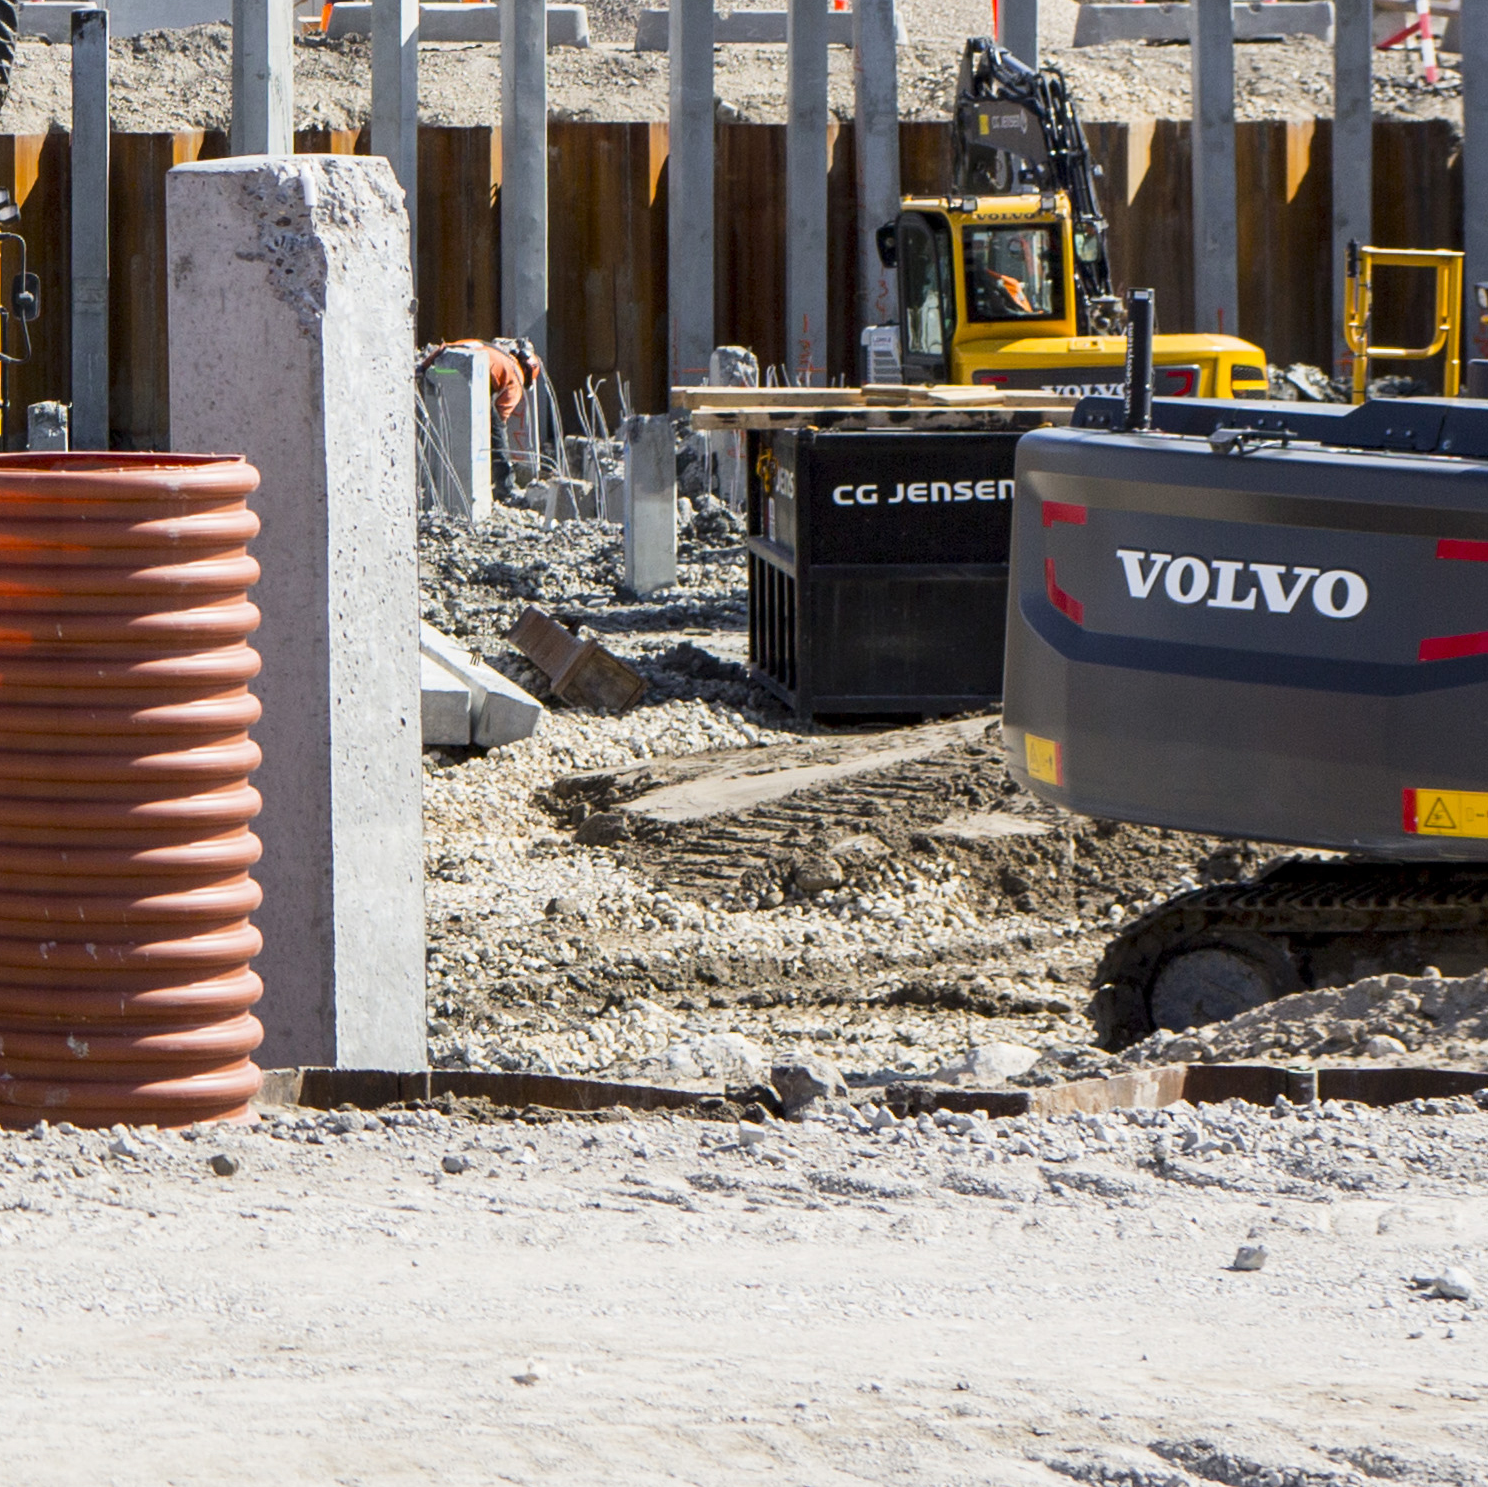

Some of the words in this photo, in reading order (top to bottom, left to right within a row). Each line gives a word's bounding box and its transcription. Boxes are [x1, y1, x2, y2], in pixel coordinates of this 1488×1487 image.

[977, 212, 1035, 221] VOLVO
[833, 484, 878, 505] CG
[888, 479, 1016, 504] JENSEN
[1116, 549, 1368, 619] VOLVO
